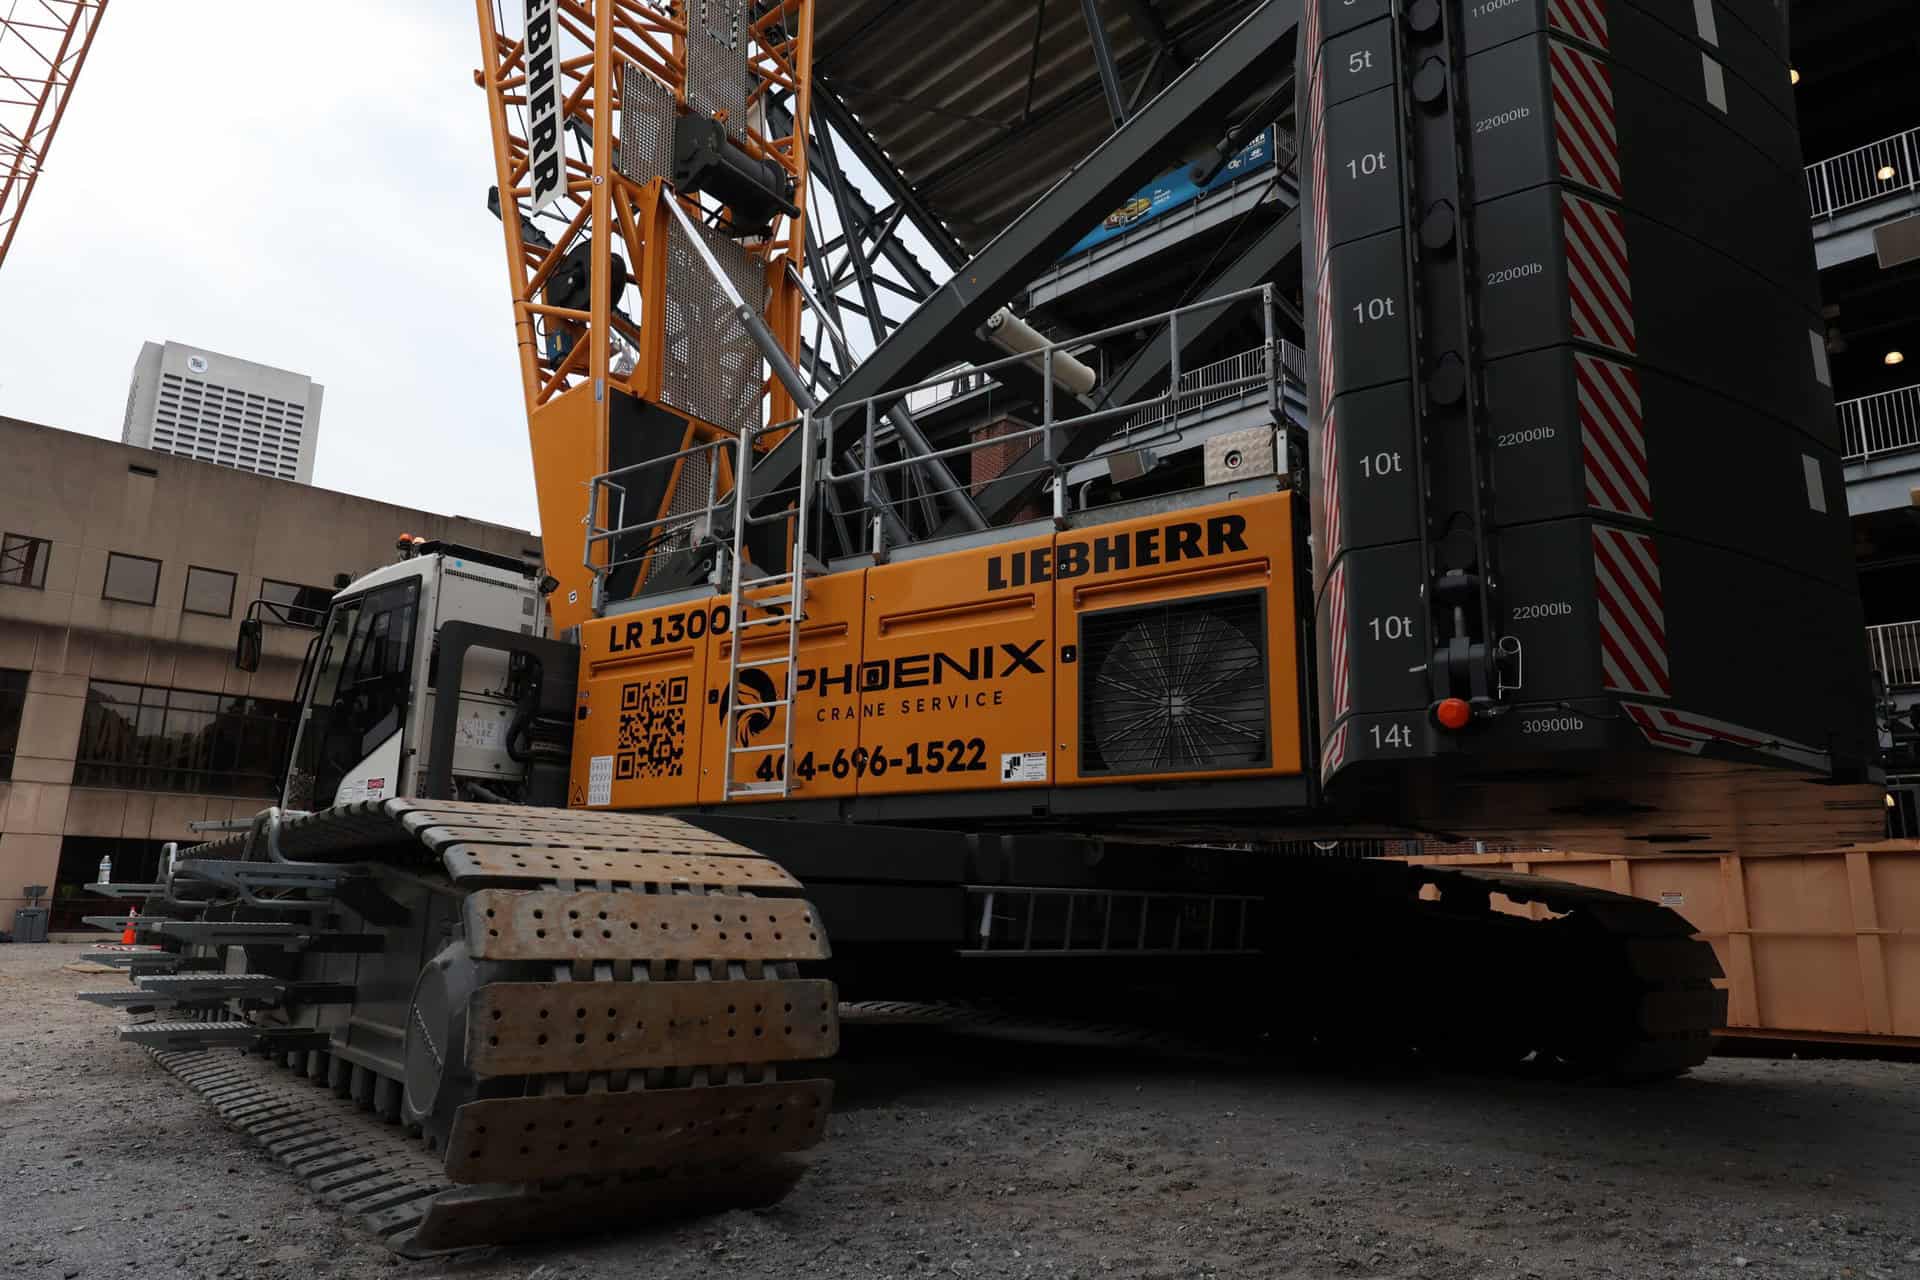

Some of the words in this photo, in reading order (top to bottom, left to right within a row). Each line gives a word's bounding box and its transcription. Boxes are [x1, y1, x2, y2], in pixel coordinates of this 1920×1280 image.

[1348, 50, 1374, 73] 5t
[1475, 106, 1530, 133] 22000lb
[1345, 151, 1387, 180] 10t
[1487, 262, 1543, 286] 22000lb
[1352, 296, 1396, 324] 10t
[1497, 425, 1556, 447] 22000lb
[1359, 451, 1403, 479] 10t
[988, 515, 1249, 591] LIEBHERR
[1512, 600, 1572, 620] 22000lb
[609, 620, 644, 653] LR
[1368, 615, 1414, 641] 10t
[784, 639, 1046, 700] PHOENIX
[816, 702, 886, 723] CRANE
[900, 689, 1003, 715] SERVICE
[1369, 722, 1413, 750] 14t
[1522, 716, 1584, 734] 30900lb
